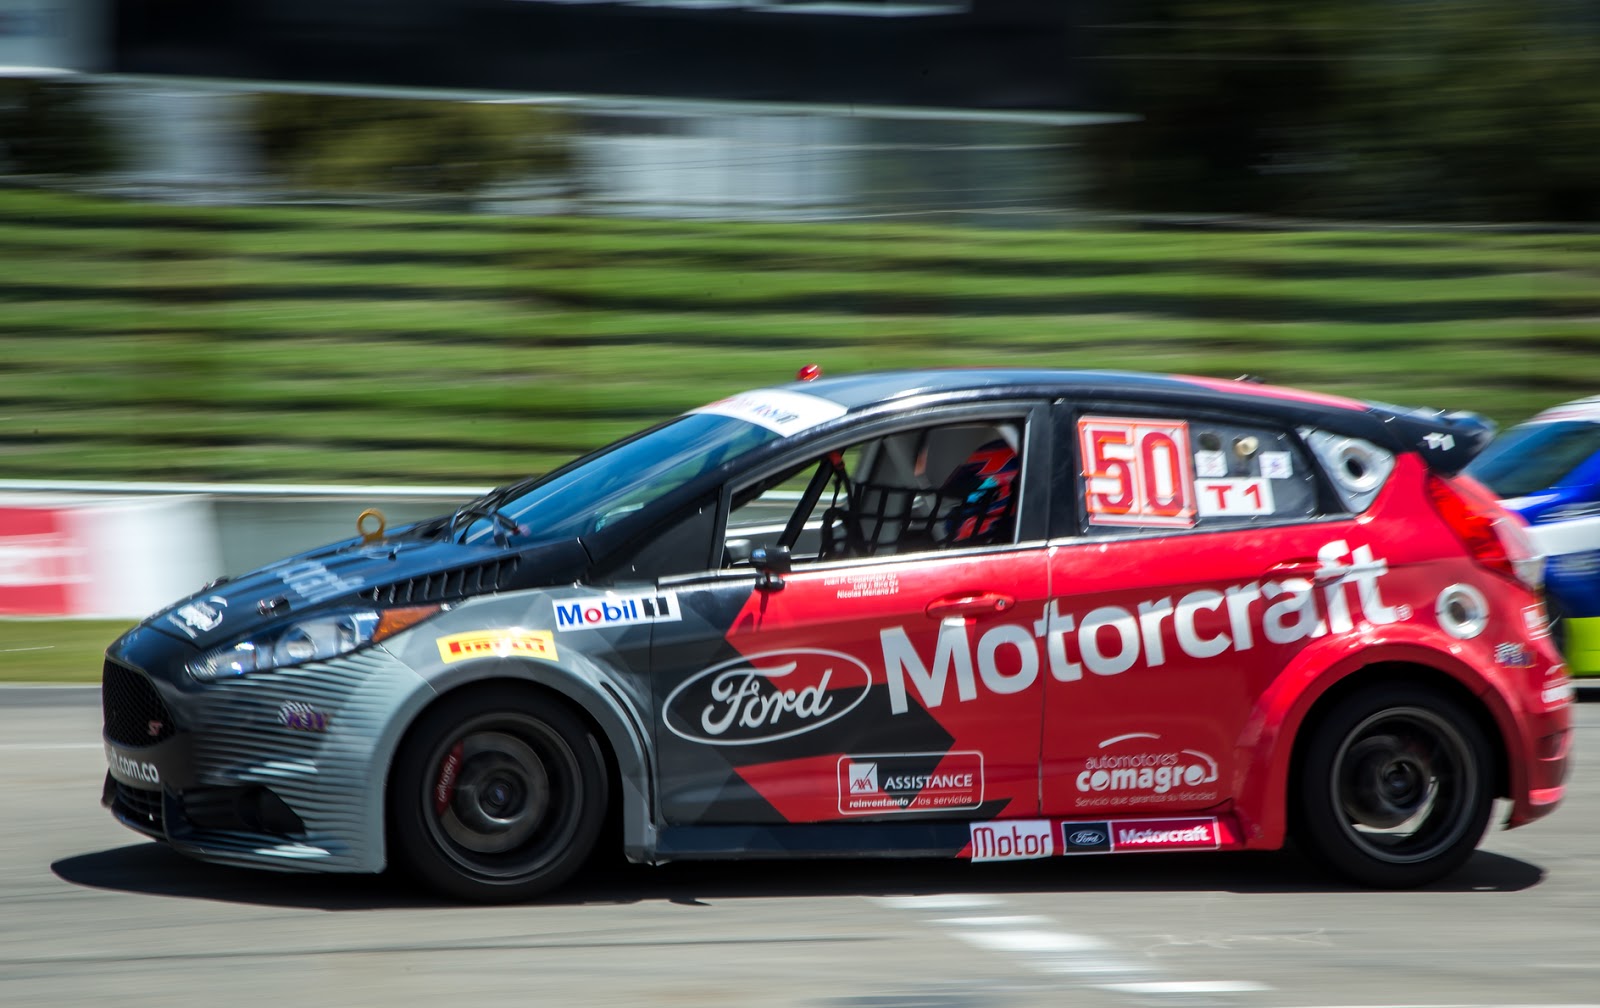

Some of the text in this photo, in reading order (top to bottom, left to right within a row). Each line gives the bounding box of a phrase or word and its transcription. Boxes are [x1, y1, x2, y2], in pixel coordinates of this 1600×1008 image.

[1092, 430, 1184, 516] 50
[1207, 484, 1263, 509] T 1
[557, 600, 637, 626] Mobil
[880, 540, 1397, 715] Motorcraft
[701, 661, 833, 735] Ford
[1085, 753, 1179, 770] automotores
[884, 774, 973, 790] ASSISTANCE
[1076, 765, 1206, 793] comagro
[849, 797, 909, 808] reinventando
[918, 796, 931, 805] los
[933, 795, 973, 804] servicios
[973, 825, 1050, 857] Motor
[1074, 831, 1100, 843] Ford
[1119, 825, 1211, 844] Motorcraft
